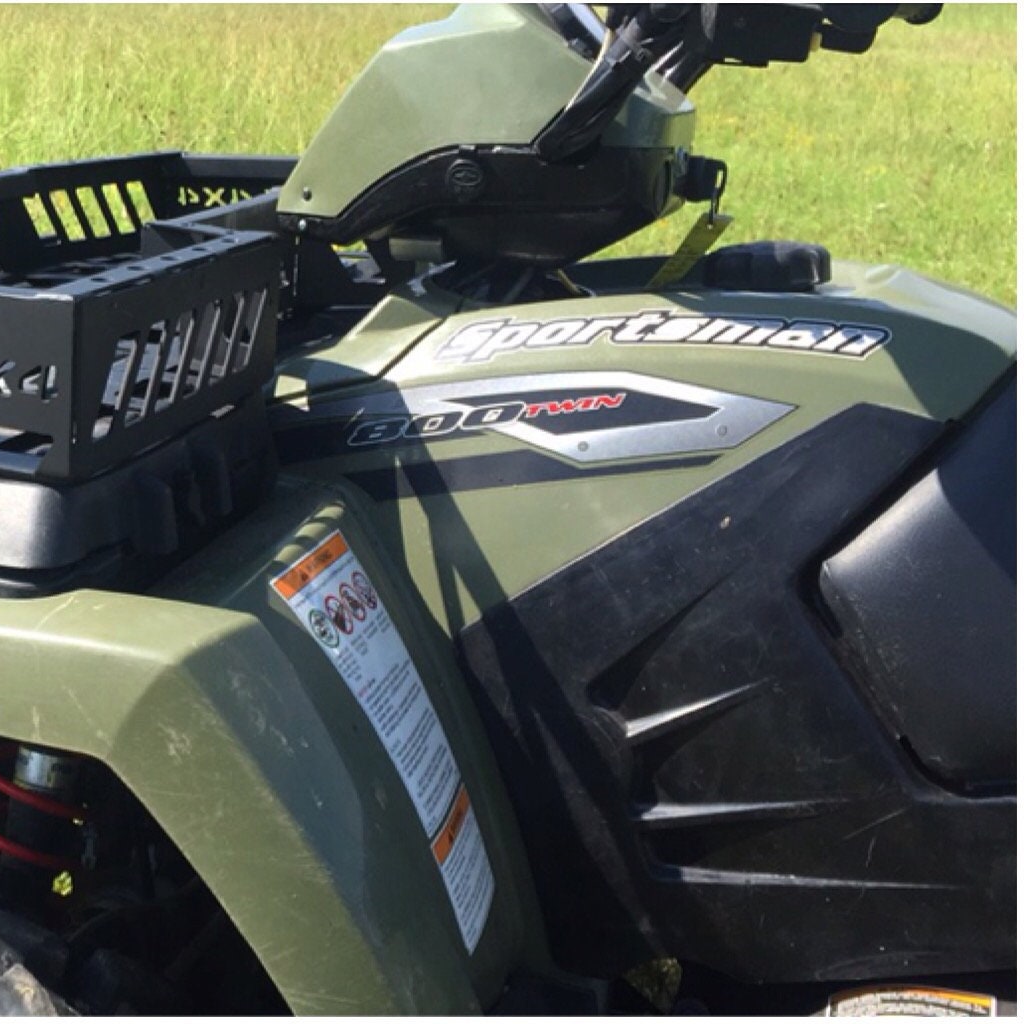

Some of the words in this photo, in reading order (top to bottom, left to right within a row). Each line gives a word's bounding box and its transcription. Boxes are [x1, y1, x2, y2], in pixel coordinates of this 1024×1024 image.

[432, 309, 893, 362] Sportsman
[347, 400, 526, 446] 800
[525, 392, 627, 418] TWIN
